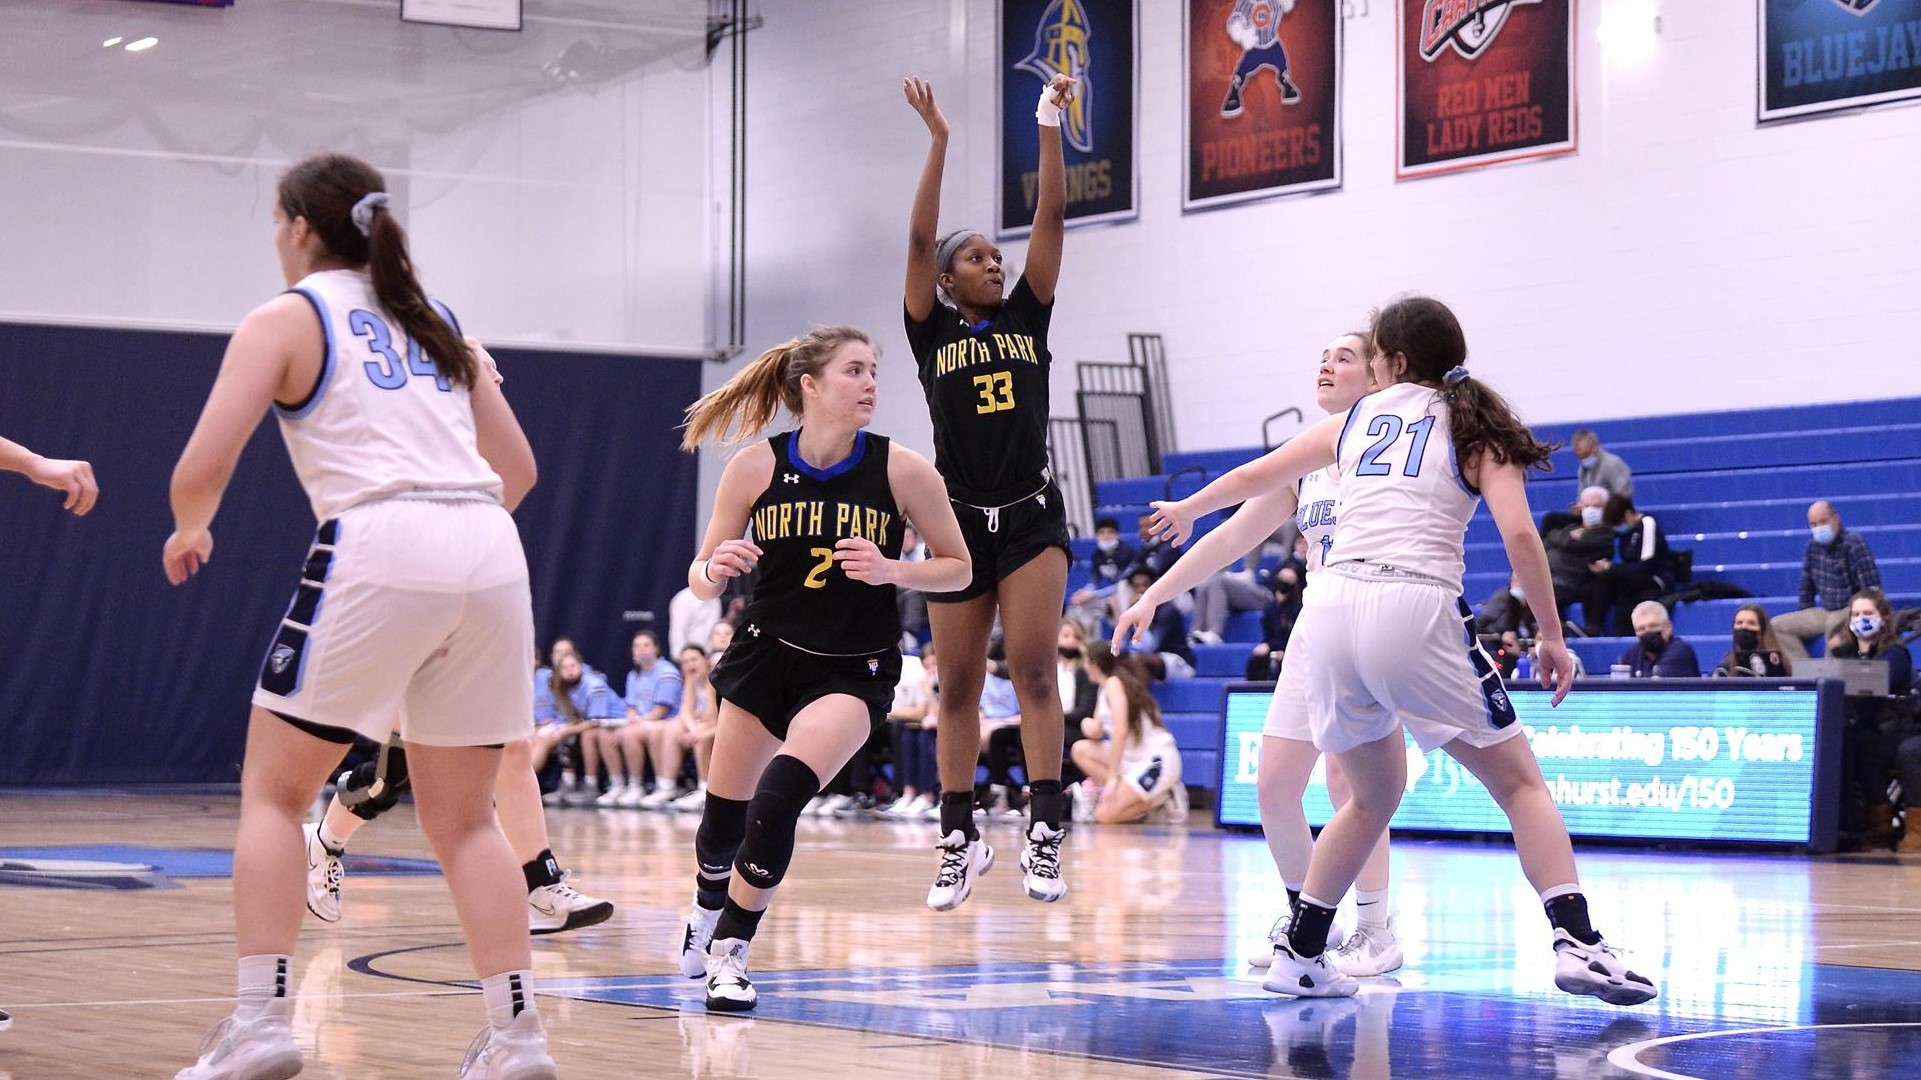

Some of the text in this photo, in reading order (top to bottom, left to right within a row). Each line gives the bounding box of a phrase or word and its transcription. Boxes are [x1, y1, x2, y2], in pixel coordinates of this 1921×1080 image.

[1437, 71, 1530, 119] RED MEN
[1427, 105, 1542, 155] LADY REDS
[1202, 123, 1320, 183] PIONEERS
[1020, 159, 1112, 209] VNGS
[937, 333, 1039, 378] NORTH PARK
[973, 371, 1016, 414] 33
[1356, 414, 1436, 478] 21
[756, 501, 891, 546] NORTH PARK
[804, 547, 834, 589] 2
[1669, 726, 1719, 761] 150
[1724, 726, 1803, 762] Years
[1545, 774, 1735, 812] hurst.edu/150
